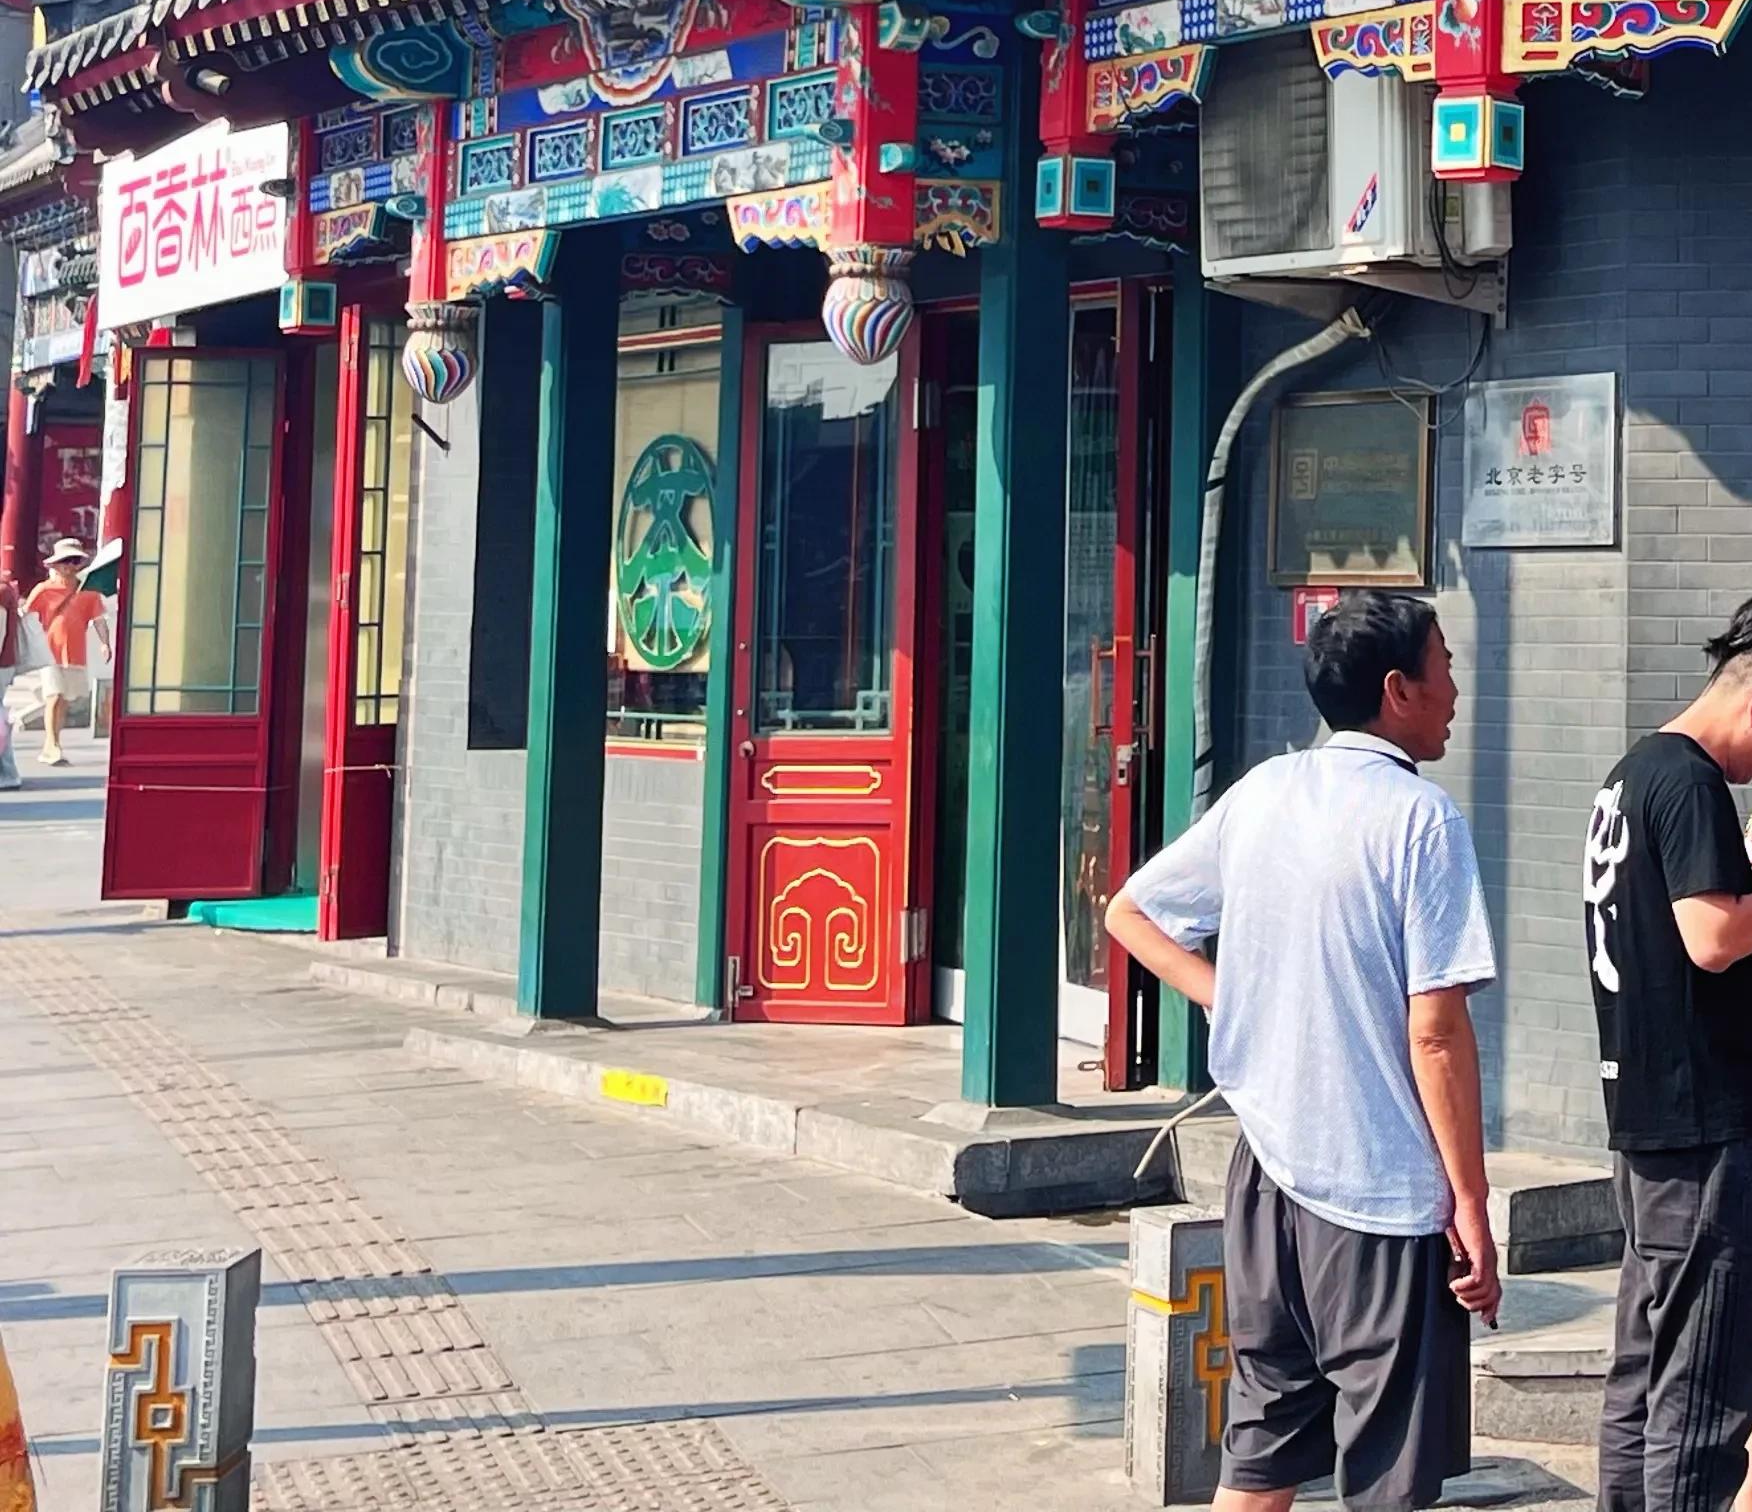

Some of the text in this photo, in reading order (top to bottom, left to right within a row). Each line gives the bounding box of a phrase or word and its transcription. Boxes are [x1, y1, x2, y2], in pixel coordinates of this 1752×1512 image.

[1484, 464, 1588, 486] 北京老字号
